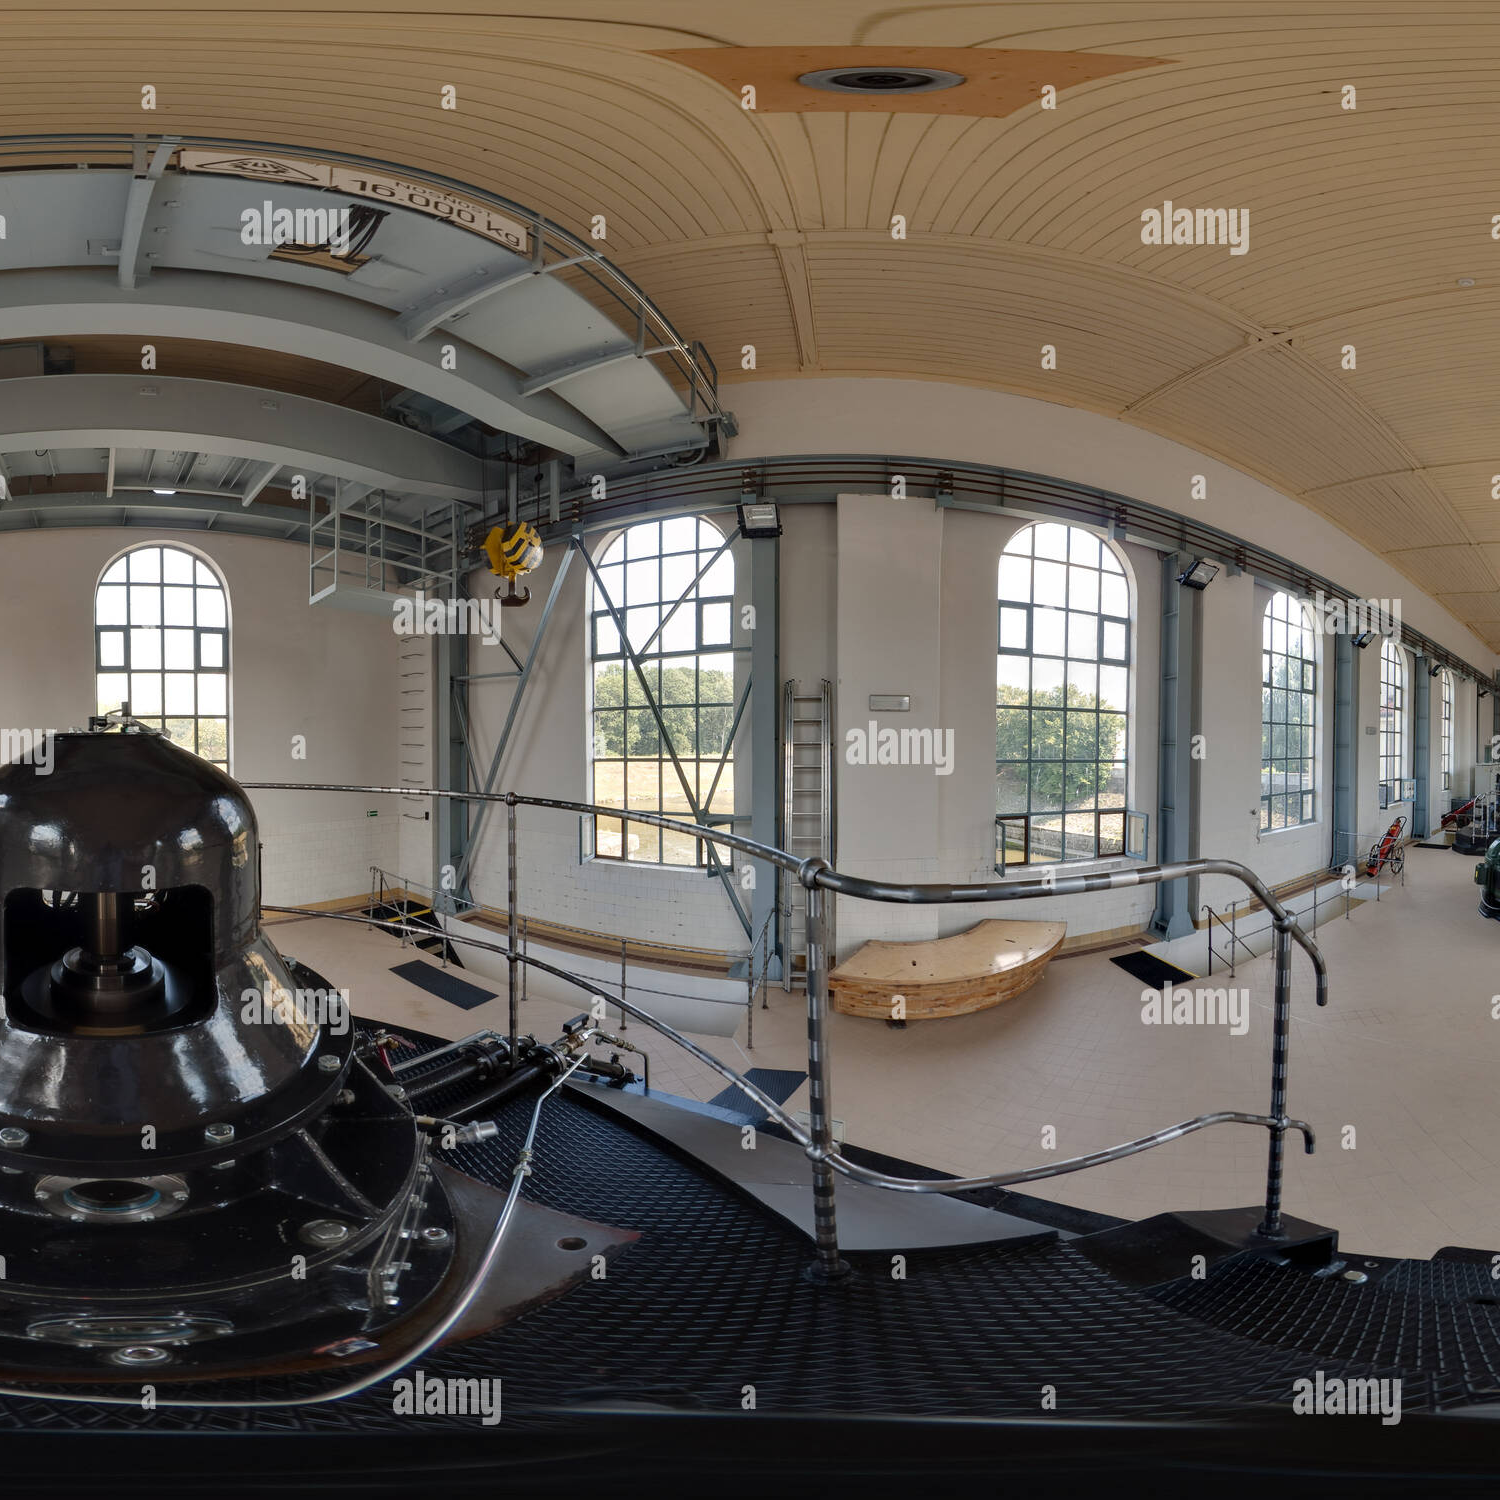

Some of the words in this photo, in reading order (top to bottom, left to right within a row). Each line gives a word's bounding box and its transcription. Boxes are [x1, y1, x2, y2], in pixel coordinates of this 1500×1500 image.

[349, 179, 475, 223] 16.000
[486, 220, 520, 247] kg
[395, 181, 492, 217] NOSNOST
